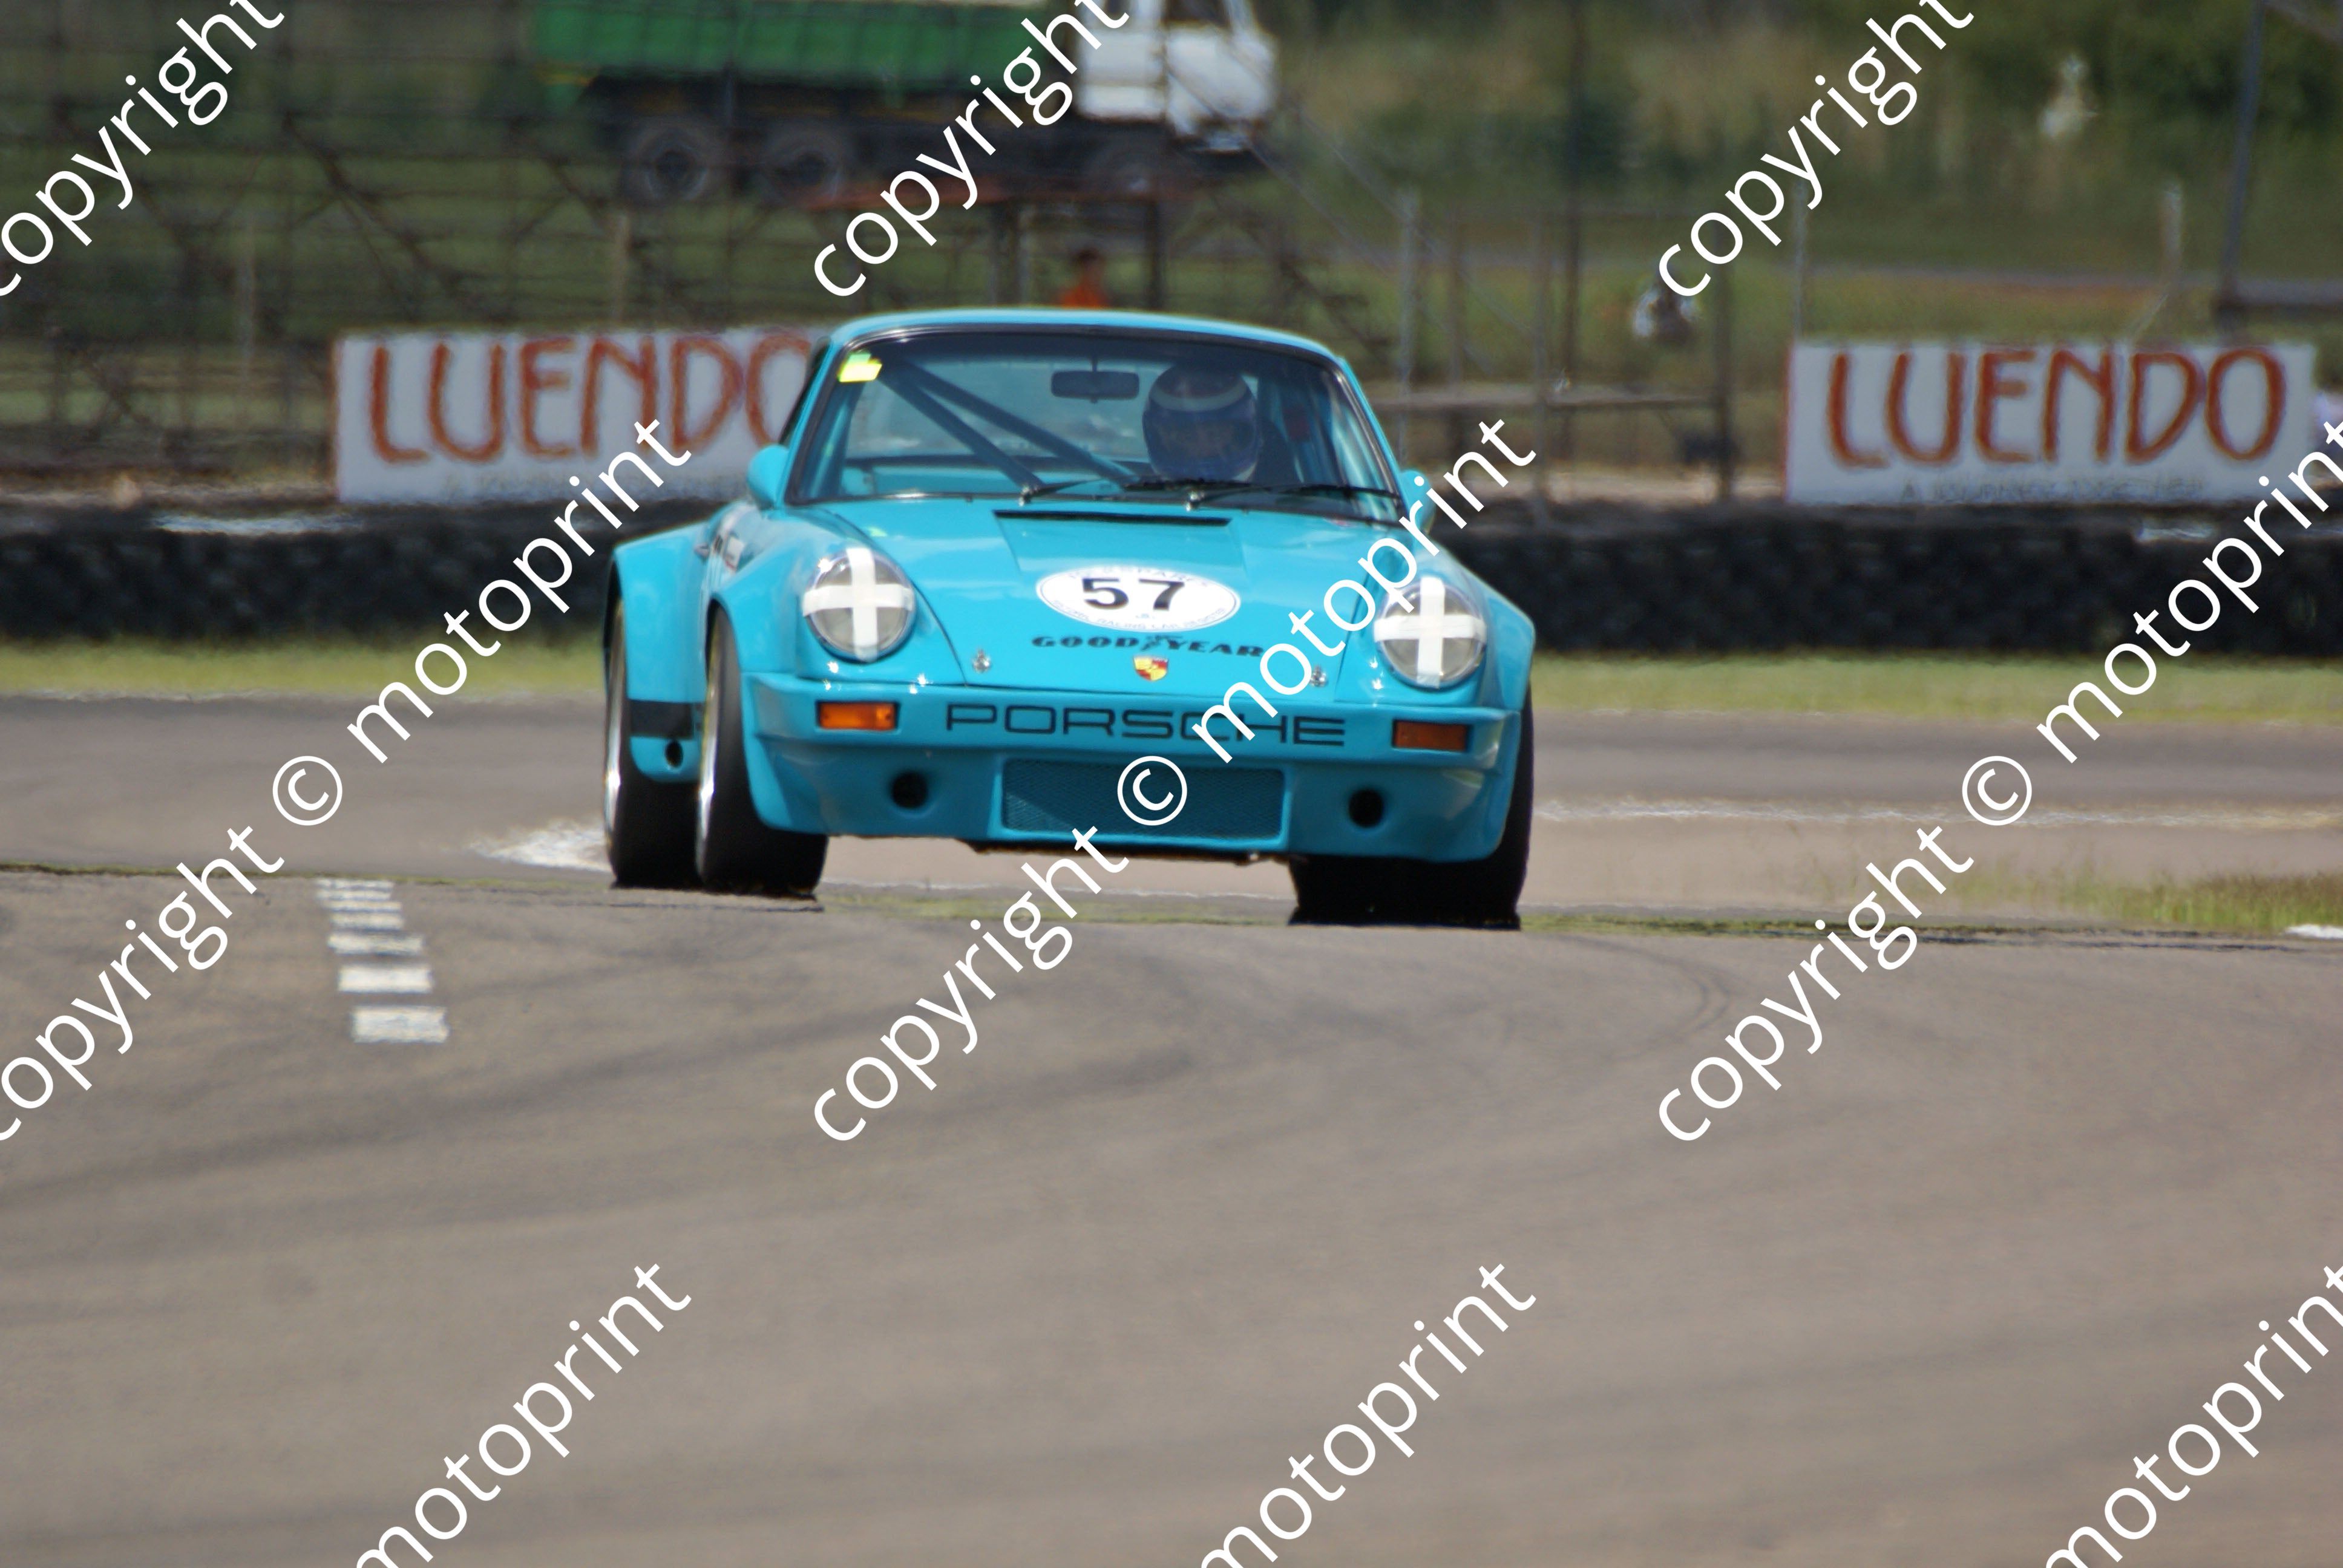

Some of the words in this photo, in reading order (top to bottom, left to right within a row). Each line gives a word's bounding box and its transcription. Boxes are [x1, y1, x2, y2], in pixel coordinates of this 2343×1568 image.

[369, 333, 811, 465] LUENDO
[1825, 345, 2287, 471] LUENDO
[1082, 577, 1185, 611] 57
[946, 704, 1345, 746] PORSCHE
